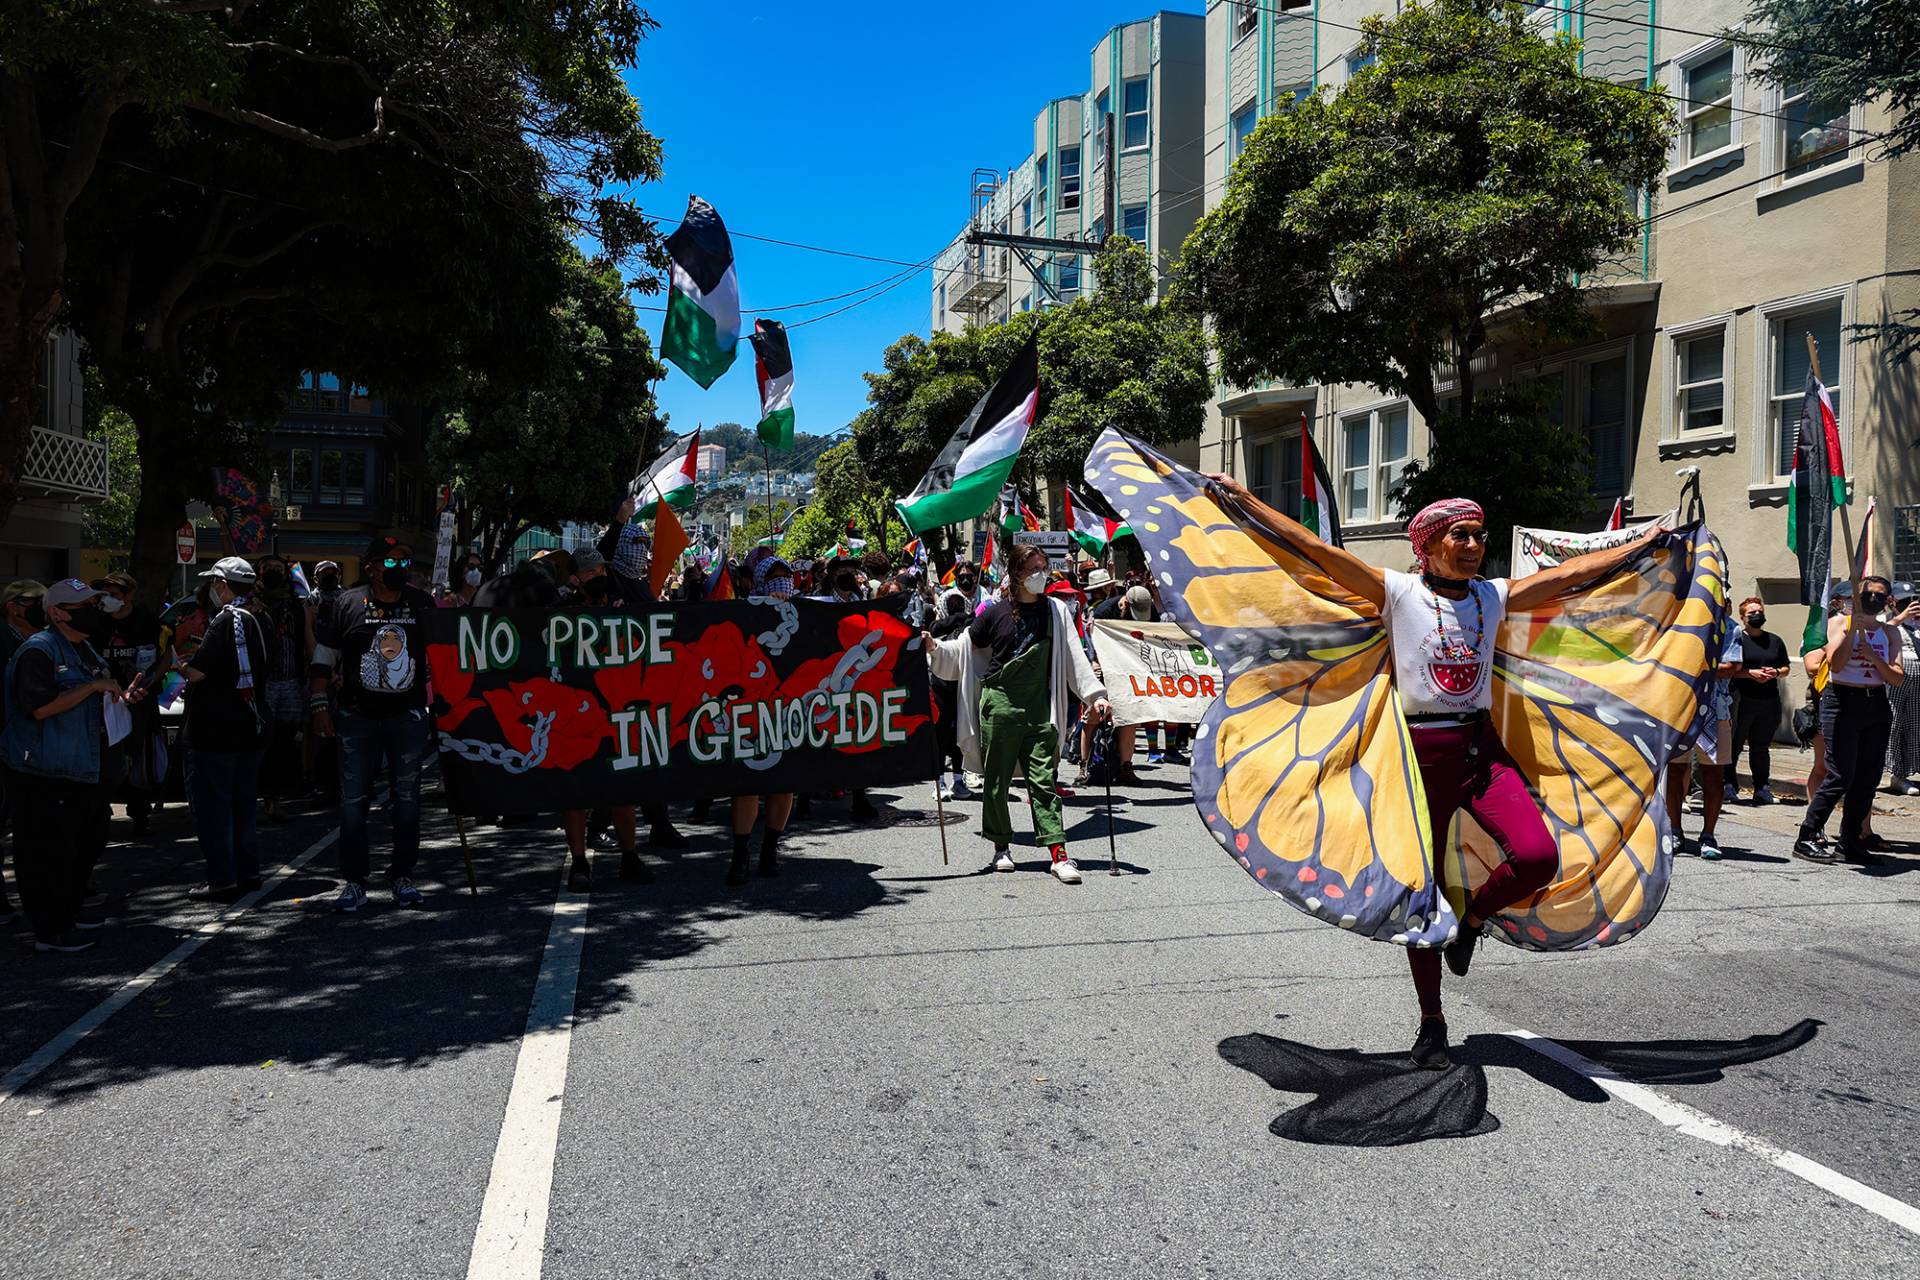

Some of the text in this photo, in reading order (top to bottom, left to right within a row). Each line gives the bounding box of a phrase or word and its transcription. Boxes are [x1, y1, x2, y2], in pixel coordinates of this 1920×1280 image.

[458, 613, 675, 670] NO PRIDE
[1129, 675, 1217, 698] LABOR
[611, 688, 909, 771] IN GENOCIDE
